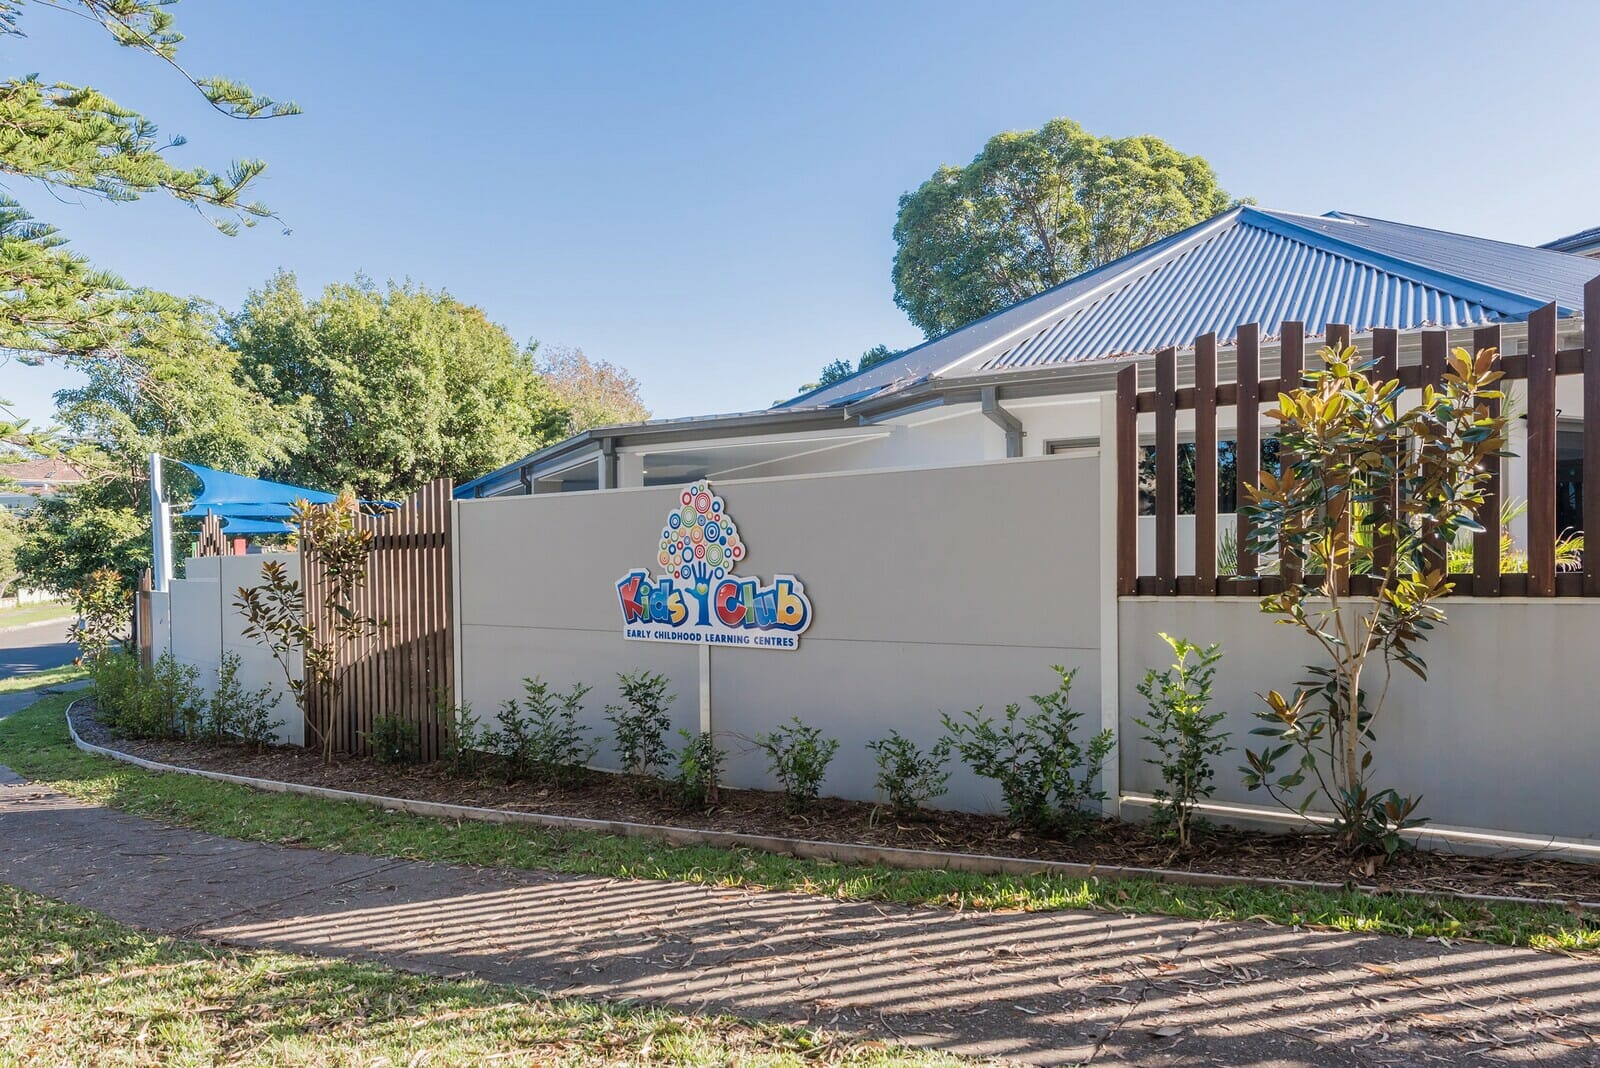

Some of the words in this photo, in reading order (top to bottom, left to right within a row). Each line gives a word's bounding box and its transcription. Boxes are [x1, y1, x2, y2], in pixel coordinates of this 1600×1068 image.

[618, 573, 688, 627] Kids
[714, 579, 807, 631] Club
[626, 629, 651, 639] EARLY
[654, 631, 702, 641] CHILDHOOD
[705, 633, 750, 644] LEARNING
[753, 636, 794, 647] CENTRES
